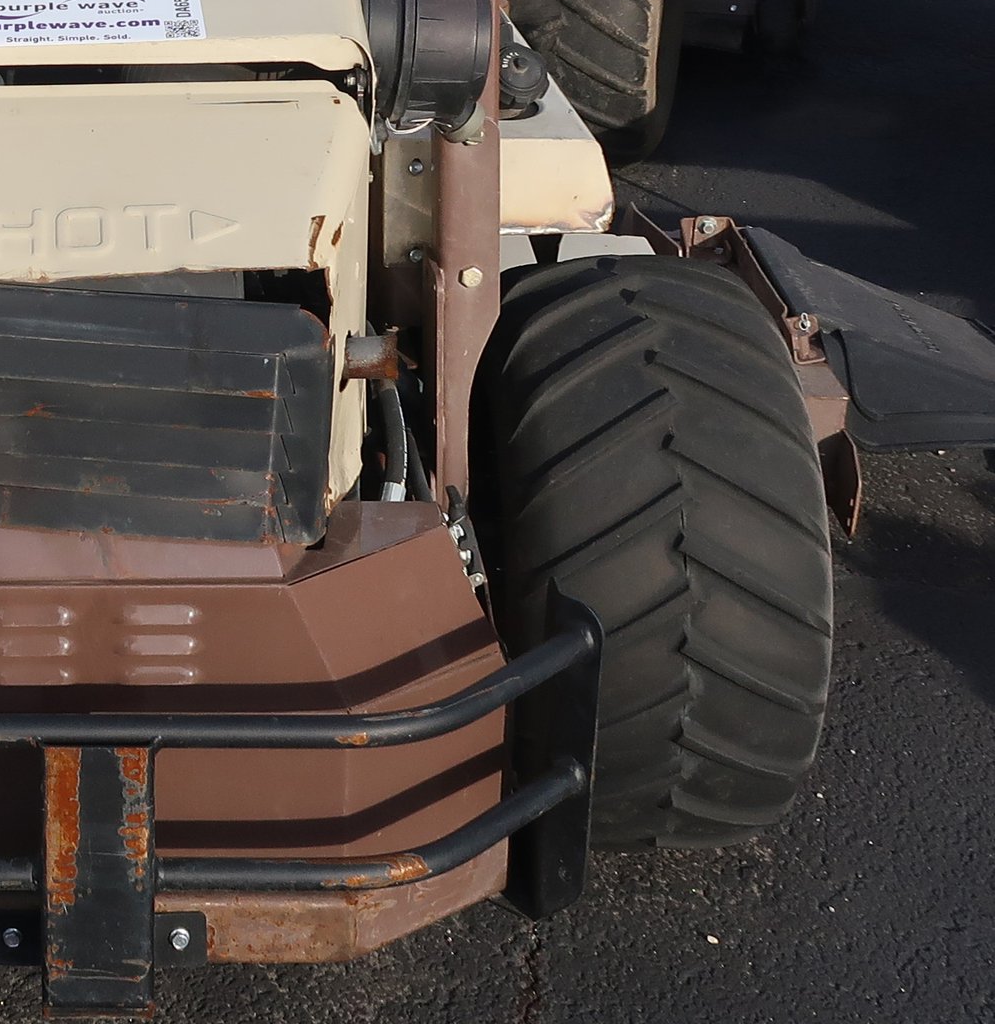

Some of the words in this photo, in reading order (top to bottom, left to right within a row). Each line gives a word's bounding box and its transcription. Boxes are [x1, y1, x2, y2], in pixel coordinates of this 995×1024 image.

[77, 1, 139, 9] wave
[6, 36, 54, 44] Straight.
[58, 35, 100, 43] Simple.
